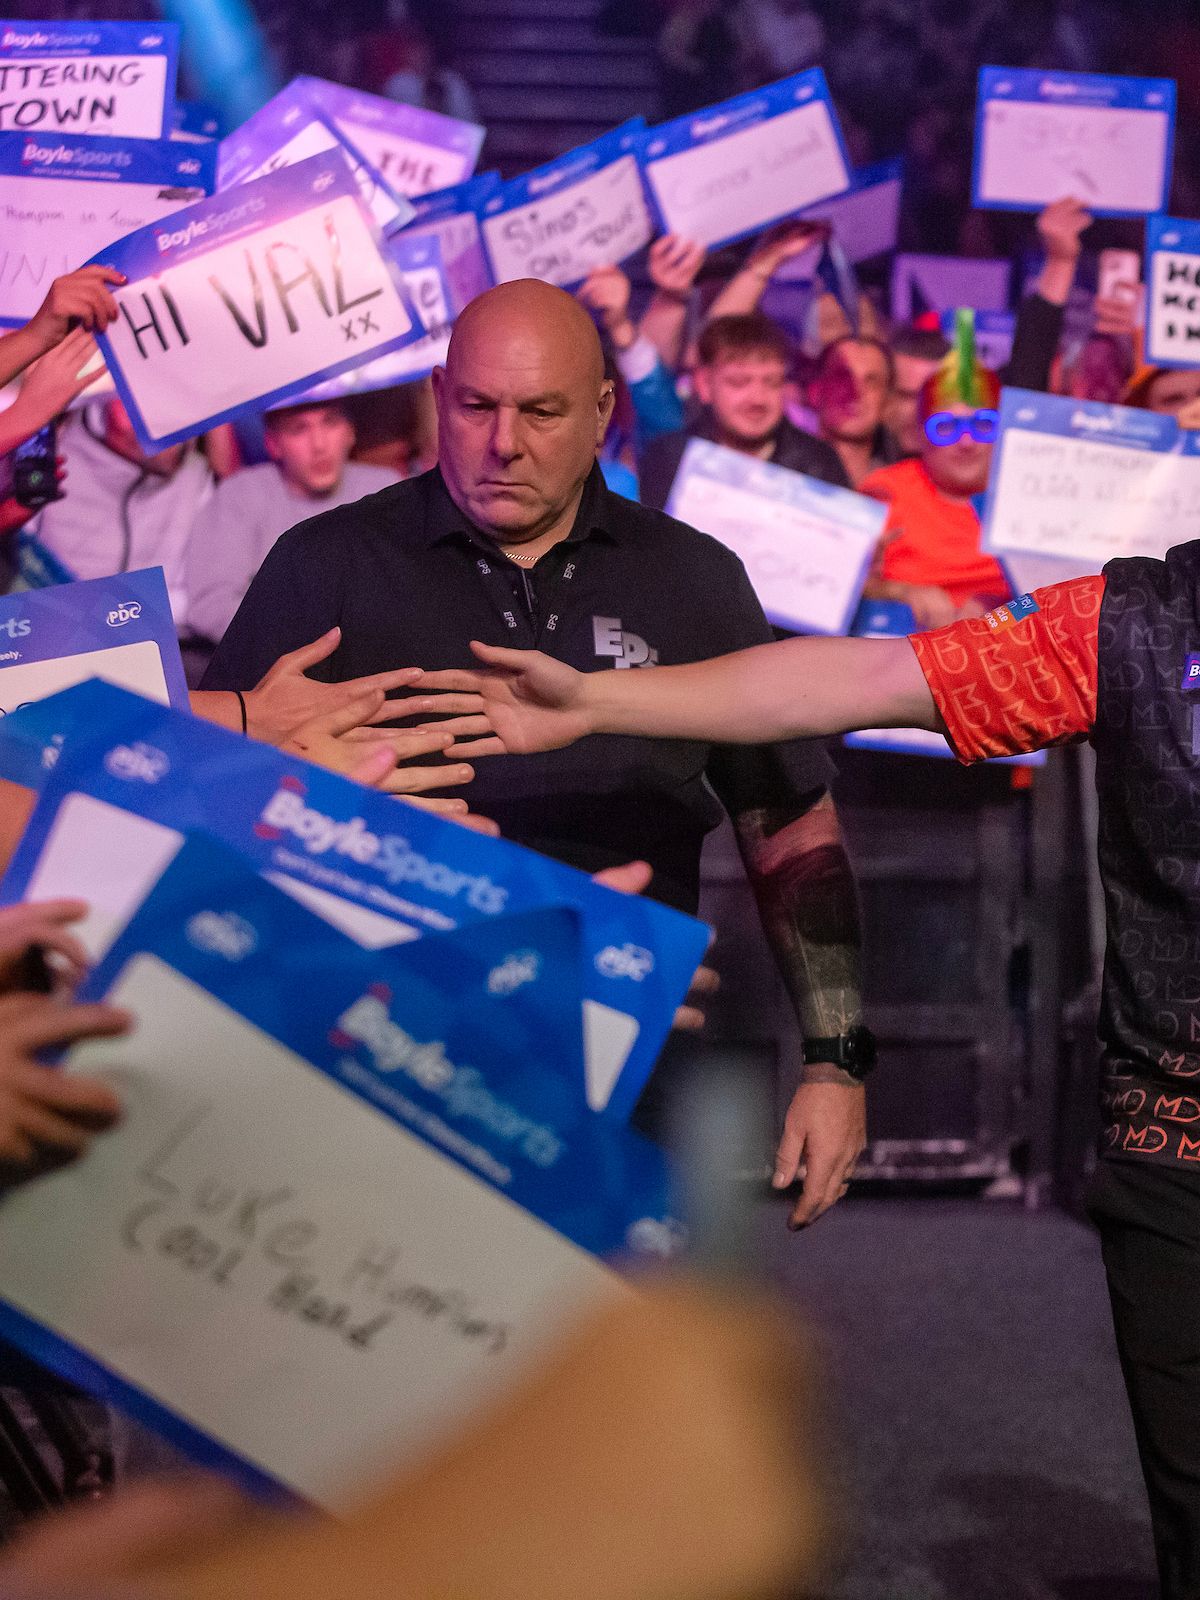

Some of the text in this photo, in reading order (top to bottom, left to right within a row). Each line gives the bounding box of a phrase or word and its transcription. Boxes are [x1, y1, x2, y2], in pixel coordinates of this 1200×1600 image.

[24, 144, 132, 167] BoyleSports
[157, 198, 266, 254] BoyleSports
[119, 284, 190, 359] HI
[208, 213, 384, 348] VAL
[563, 562, 576, 579] EPS
[106, 602, 142, 627] PDC
[504, 611, 517, 628] EPS
[547, 613, 559, 631] EPS
[261, 789, 508, 916] BoyleSports
[1123, 1125, 1167, 1153] MD
